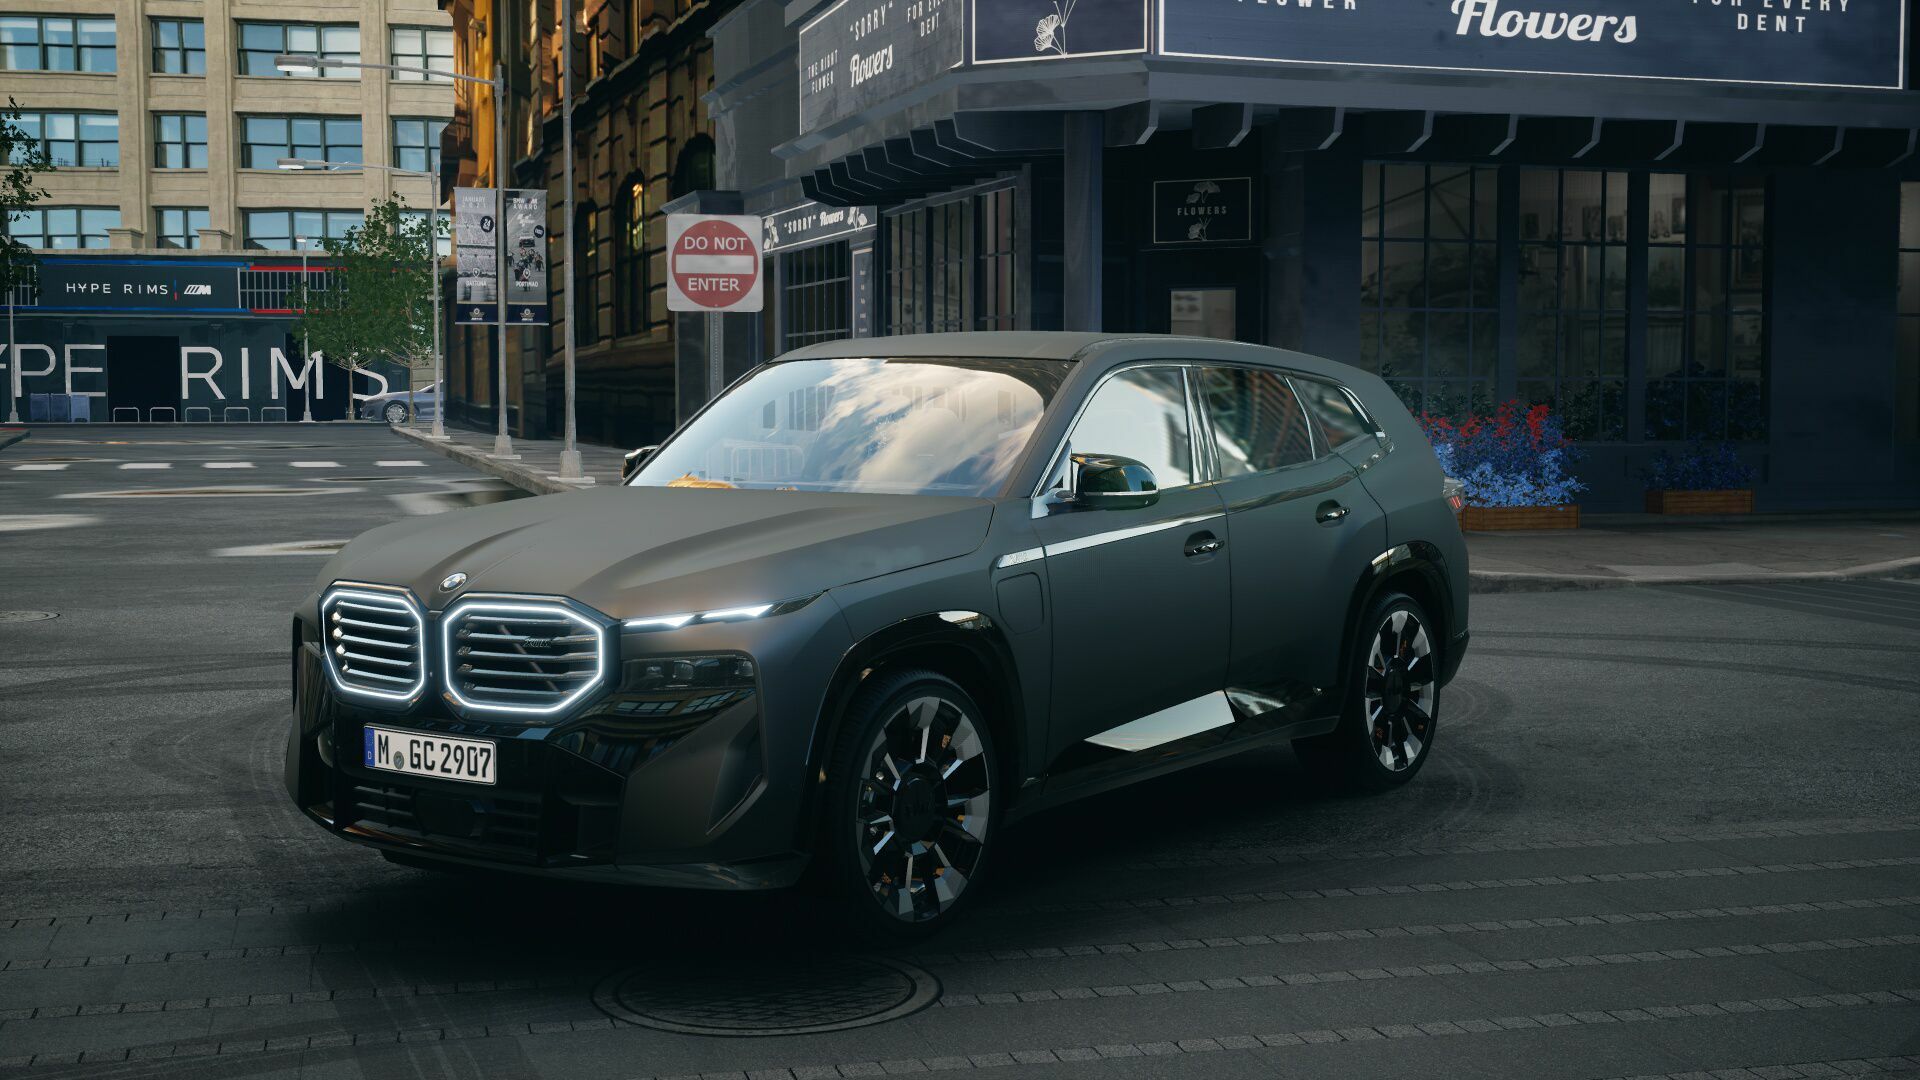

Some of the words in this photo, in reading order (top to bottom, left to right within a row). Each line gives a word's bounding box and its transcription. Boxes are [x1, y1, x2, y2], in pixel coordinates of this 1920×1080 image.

[907, 1, 923, 23] FOR
[1450, 0, 1637, 43] Flowers
[1737, 13, 1806, 33] DENT
[920, 12, 940, 37] DENT
[808, 61, 818, 79] THE
[820, 49, 838, 72] RIGHT
[850, 44, 893, 88] Flowers
[811, 70, 834, 95] FLOWER
[1177, 206, 1227, 216] FLOWERS
[684, 237, 708, 250] DO
[714, 237, 747, 250] NOT
[66, 283, 111, 294] HYPE
[123, 284, 169, 295] RIMS
[687, 278, 740, 291] ENTER
[378, 734, 389, 765] M
